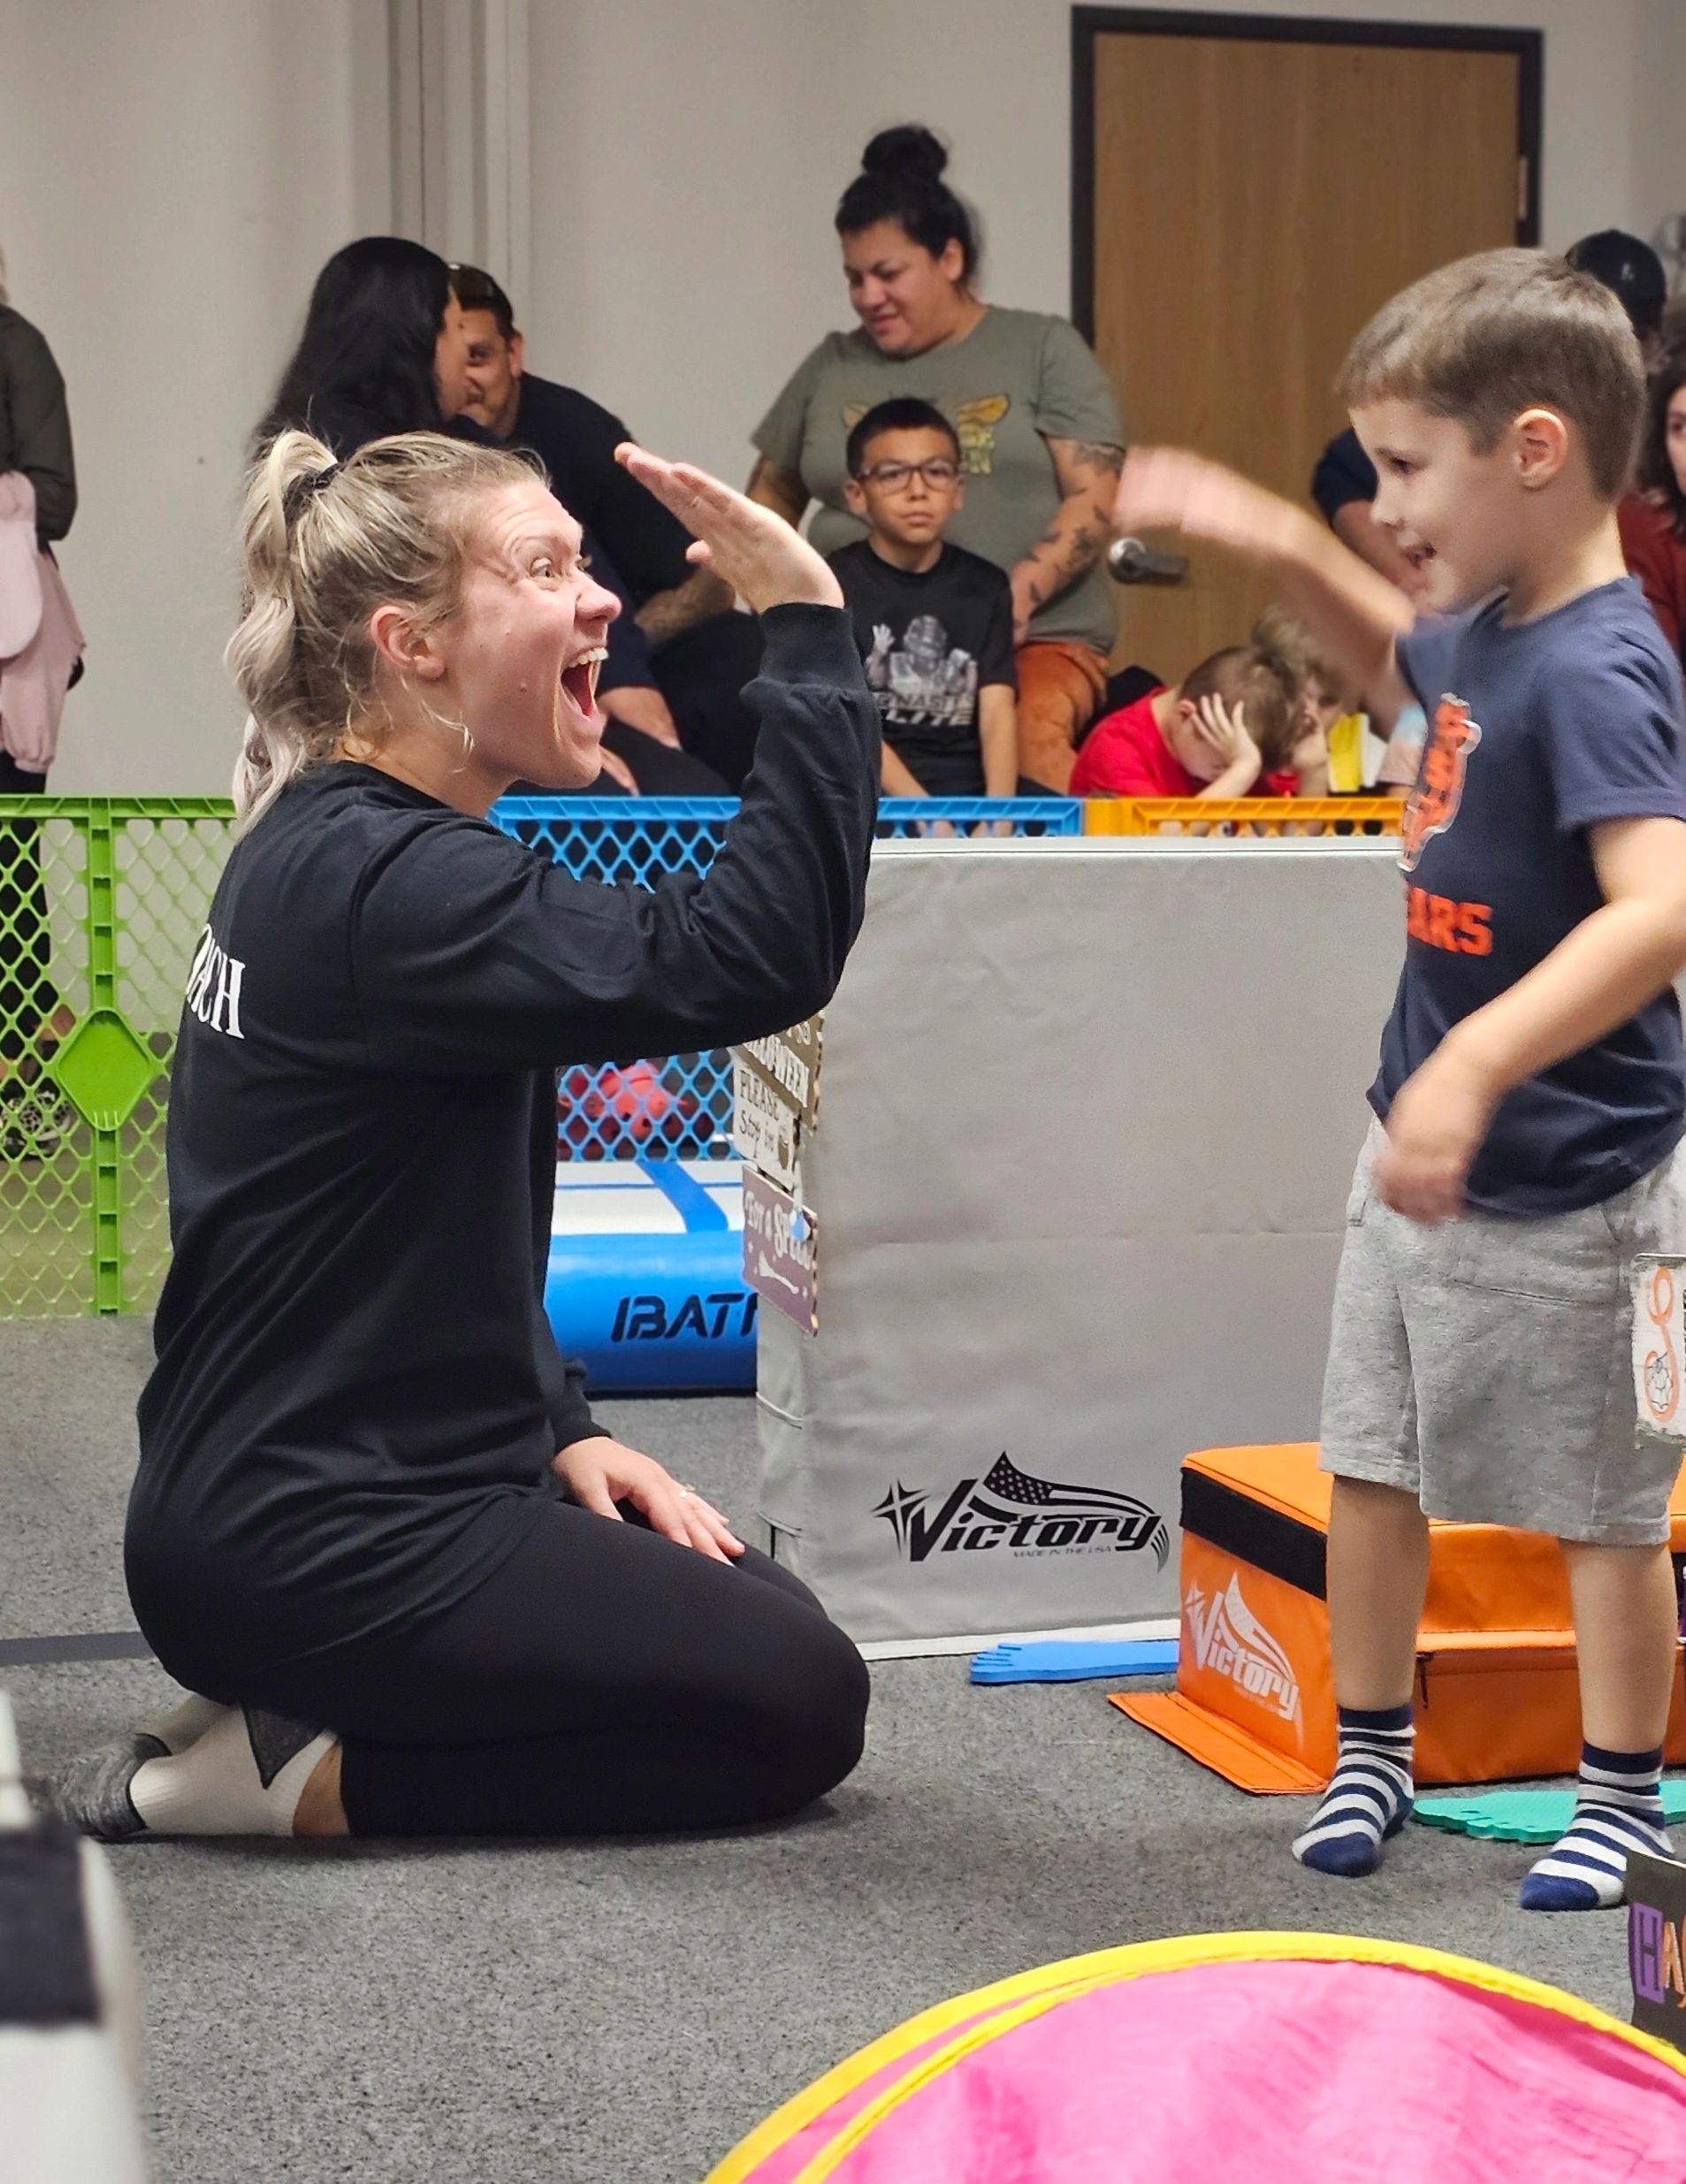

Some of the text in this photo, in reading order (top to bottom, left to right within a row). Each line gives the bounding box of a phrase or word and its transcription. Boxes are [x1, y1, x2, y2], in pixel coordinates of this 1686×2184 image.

[885, 709, 973, 726] LITE
[740, 1069, 779, 1121] PLEASE
[909, 1478, 1162, 1562] Victory
[1193, 1591, 1299, 1722] Victory
[1630, 1902, 1686, 2008] HA
